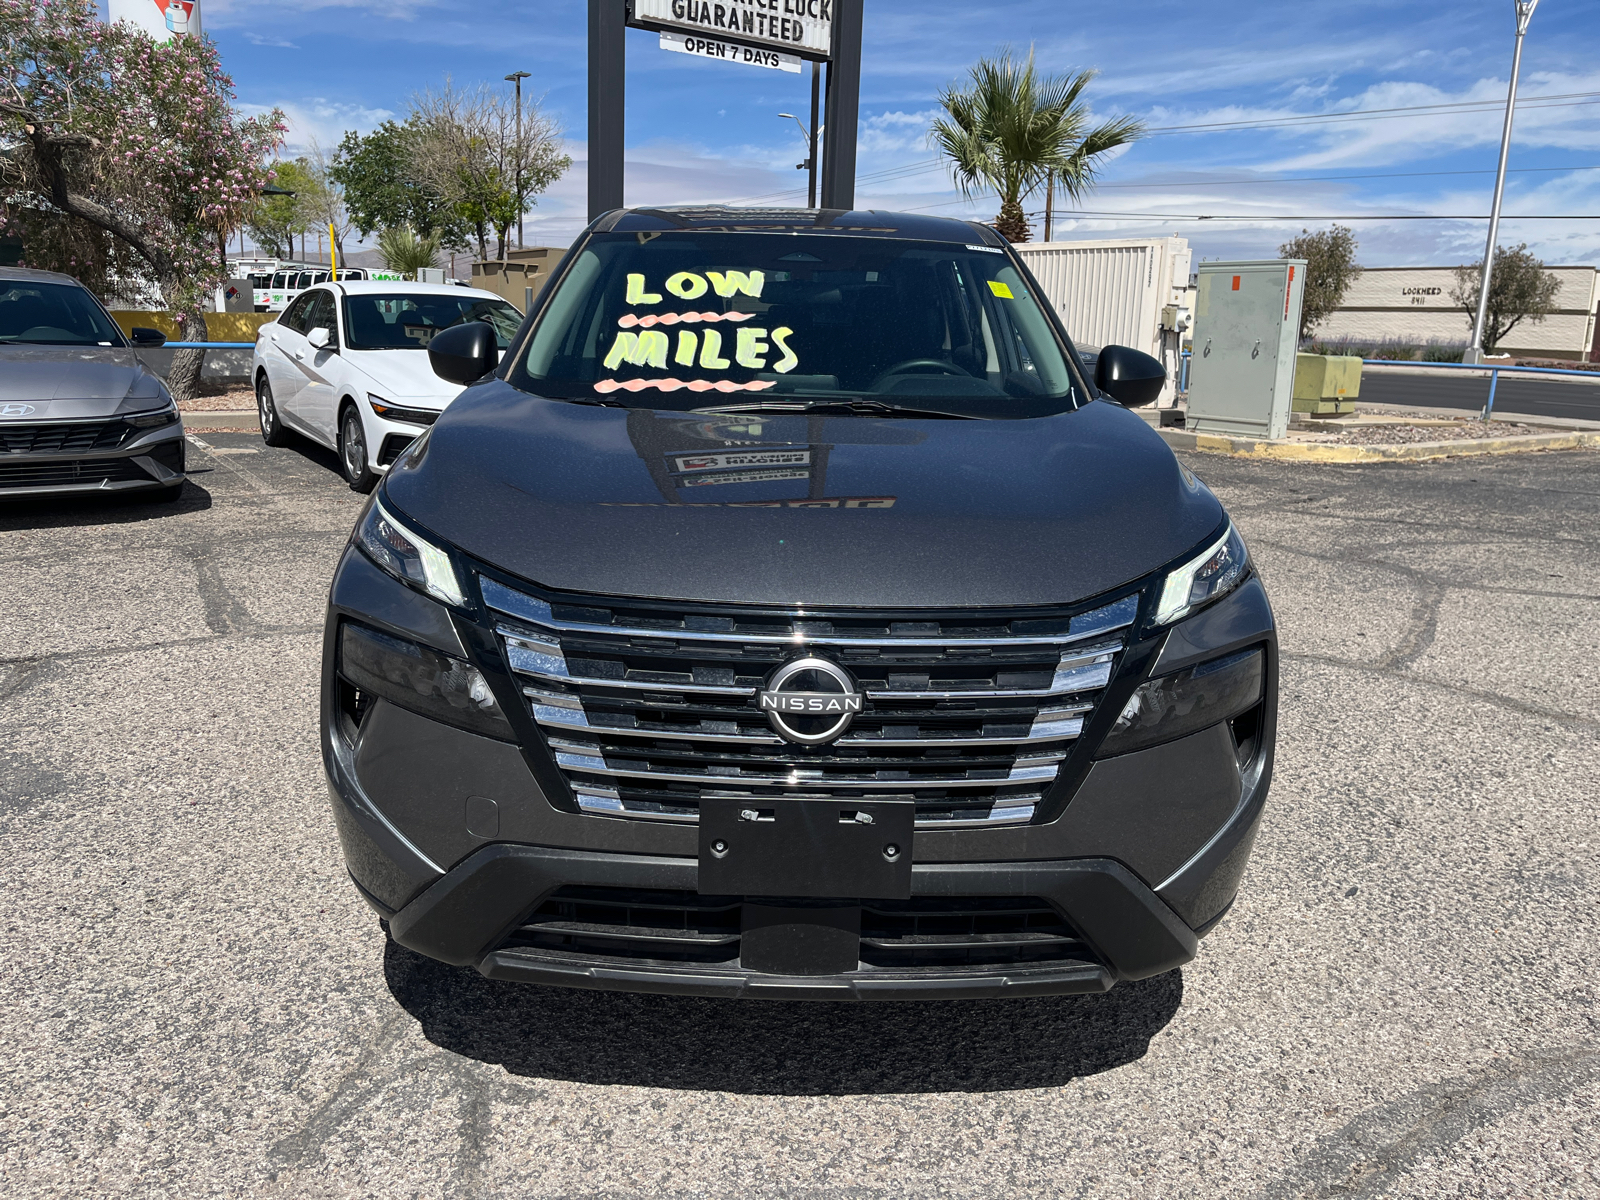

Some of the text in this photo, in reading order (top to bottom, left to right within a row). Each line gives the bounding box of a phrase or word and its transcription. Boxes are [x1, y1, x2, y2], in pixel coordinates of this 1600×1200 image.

[671, 0, 804, 41] GUARANTEED
[684, 37, 780, 67] OPEN 7 DAYS
[626, 270, 765, 306] LOW
[1402, 287, 1442, 296] LOCKHEED
[603, 326, 799, 374] MILES
[762, 694, 860, 711] NISSAN
